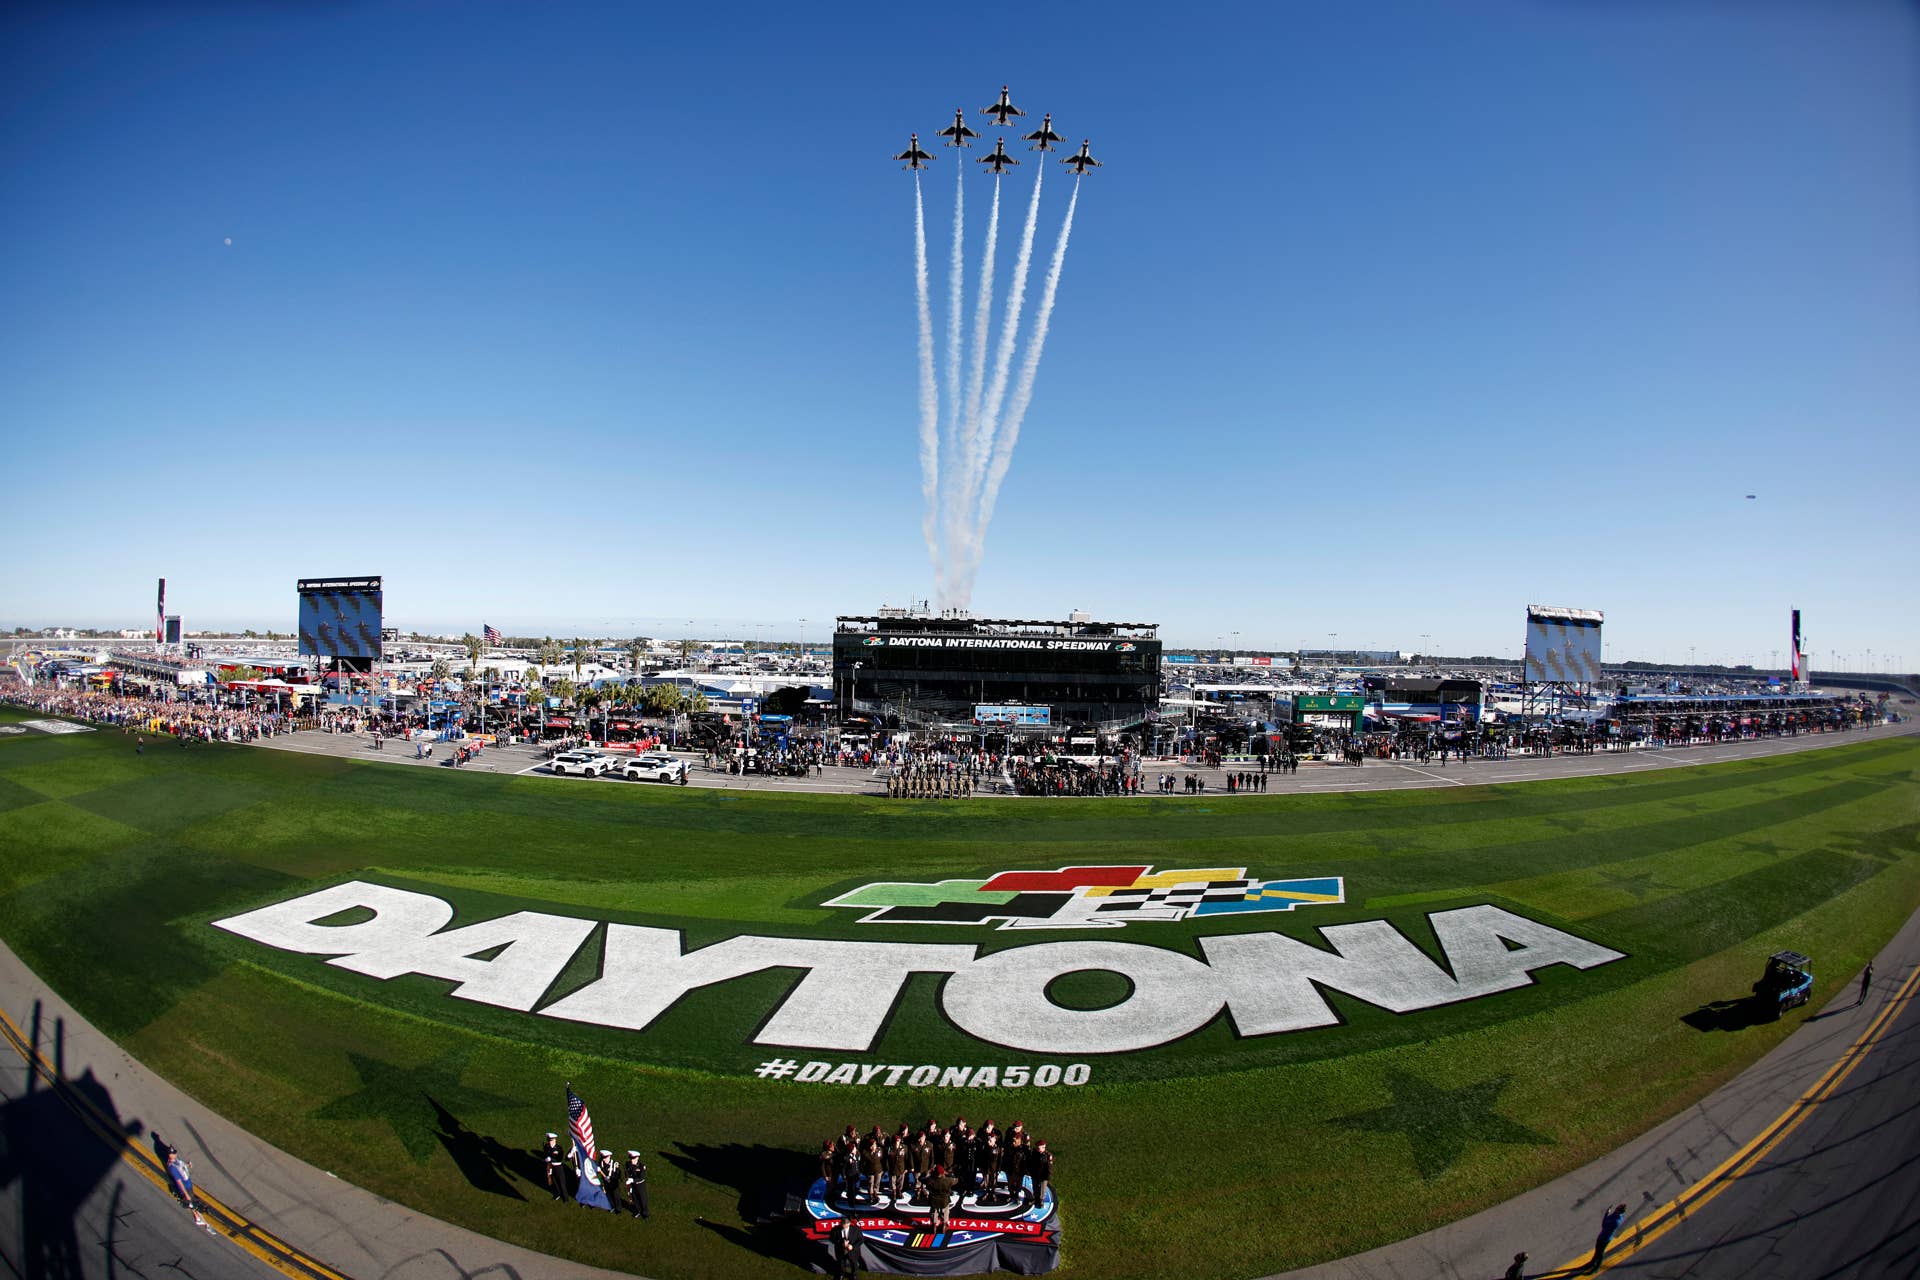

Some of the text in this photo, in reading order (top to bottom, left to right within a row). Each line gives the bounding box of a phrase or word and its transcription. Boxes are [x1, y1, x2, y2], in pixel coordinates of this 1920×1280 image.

[889, 637, 1112, 651] DAYTONA INTERNATIONAL SPEEDWAY
[209, 880, 1626, 1053] DAYTONA
[754, 1058, 1092, 1088] #DAYTONA500
[911, 1219, 989, 1228] AMICAN
[995, 1221, 1035, 1232] RACE
